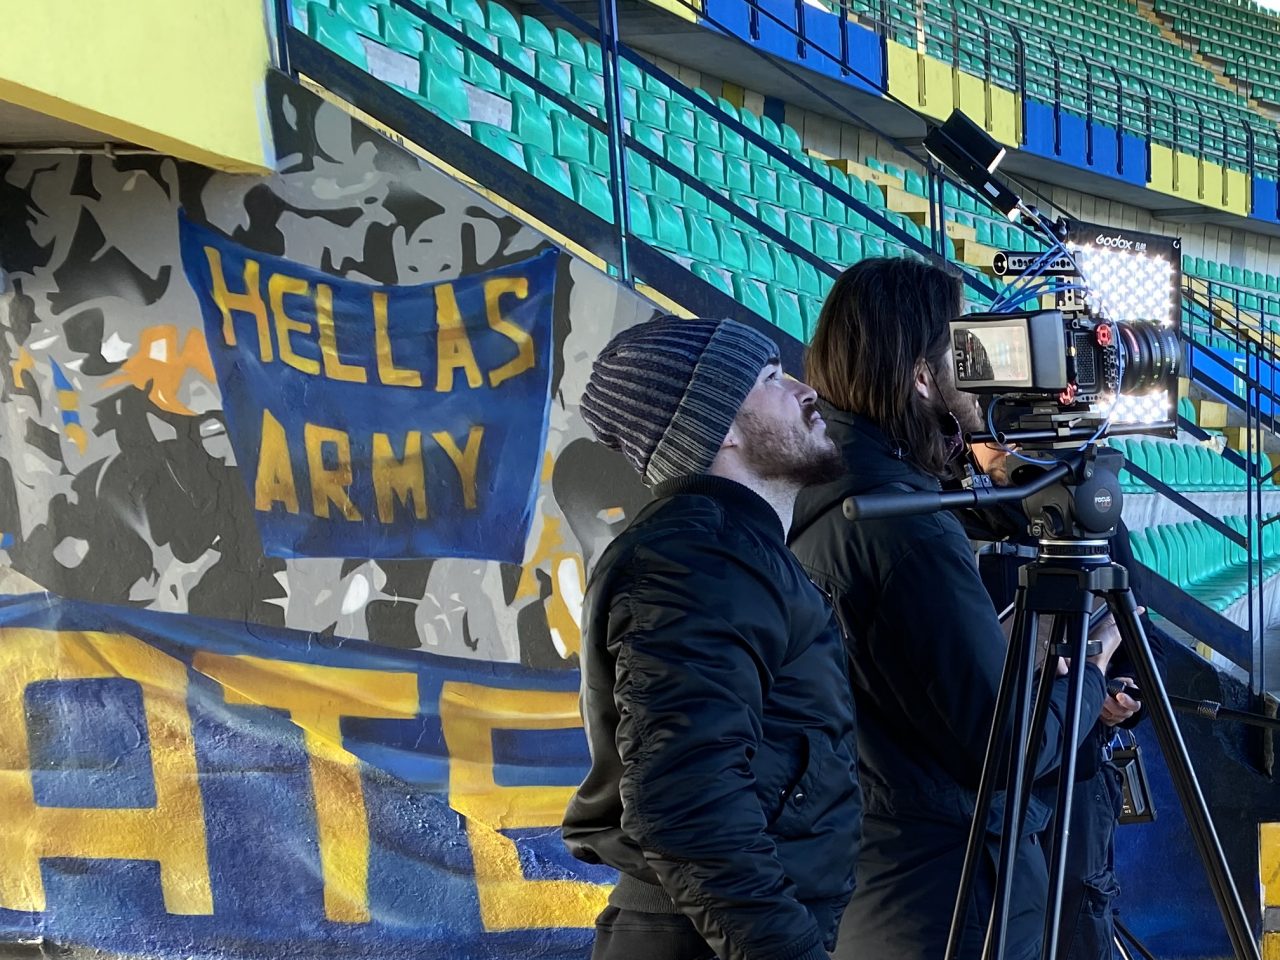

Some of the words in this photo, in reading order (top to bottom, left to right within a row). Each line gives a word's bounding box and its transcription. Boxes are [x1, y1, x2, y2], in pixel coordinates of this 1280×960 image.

[1095, 233, 1133, 250] Godox
[203, 245, 536, 393] HELLAS
[254, 408, 485, 523] ARMY
